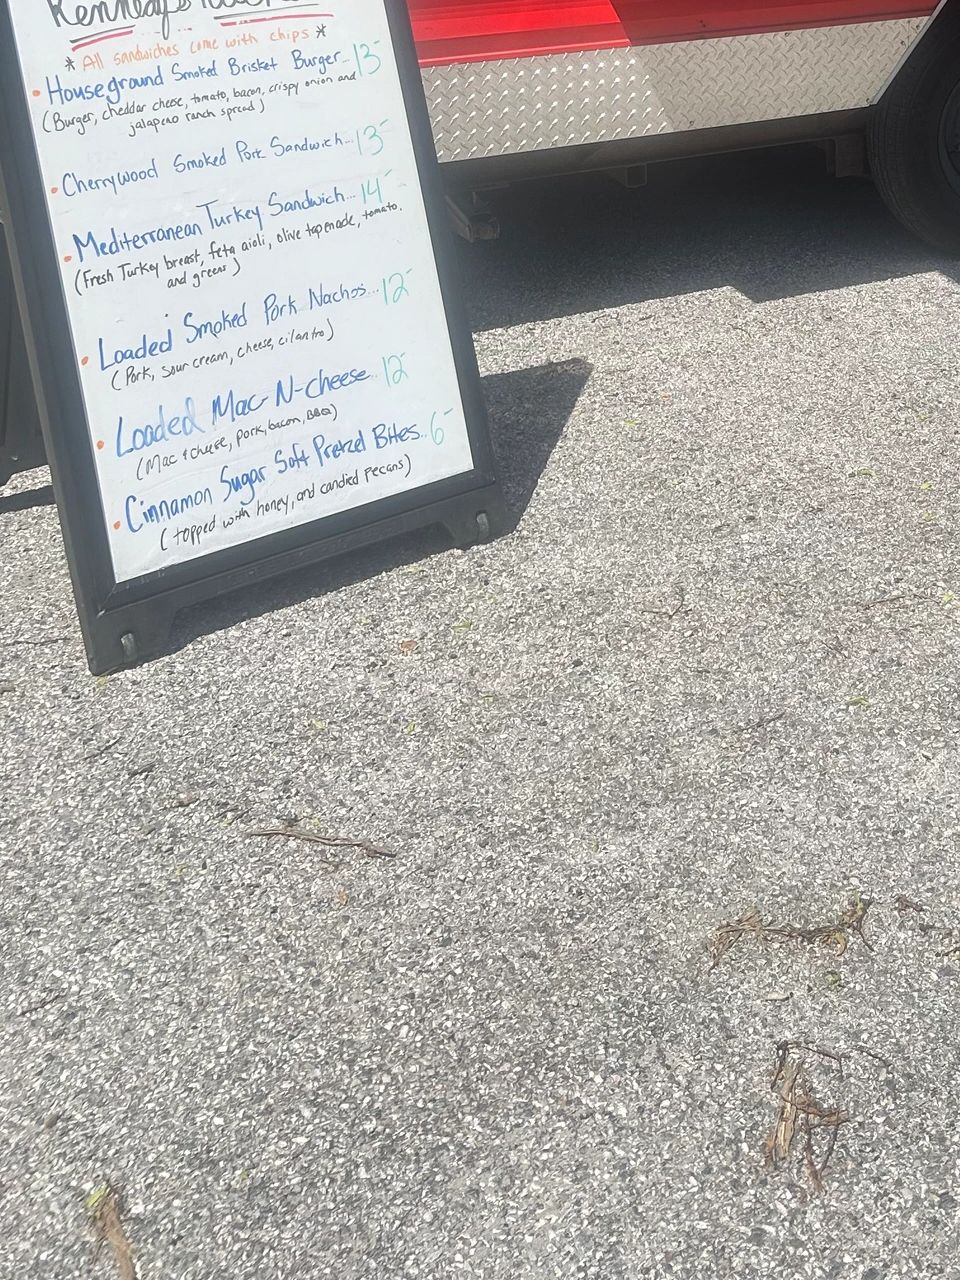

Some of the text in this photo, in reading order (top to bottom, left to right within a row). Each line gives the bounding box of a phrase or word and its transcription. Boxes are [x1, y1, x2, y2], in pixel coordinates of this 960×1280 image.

[82, 52, 105, 71] All
[113, 44, 180, 66] sandwiches
[225, 32, 258, 48] with
[270, 27, 310, 45] chips
[171, 59, 219, 82] Smoked
[227, 56, 278, 77] Brisket
[101, 100, 147, 121] cheddar
[268, 80, 300, 97] crispy
[304, 76, 333, 88] onion
[338, 71, 357, 82] and
[185, 108, 217, 122] ranch
[173, 147, 227, 173] Smoked
[235, 139, 268, 163] Pork
[72, 222, 203, 263] Mediterranean
[195, 199, 263, 232] Turkey
[117, 261, 160, 281] Turkey
[208, 240, 236, 260] feta
[276, 227, 301, 244] olive
[167, 270, 188, 289] and
[98, 328, 173, 372] Loaded
[183, 301, 248, 344] Smoked
[263, 292, 298, 326] Pork
[161, 361, 190, 379] sour
[115, 396, 206, 458] Loaded
[125, 486, 213, 534] Cinnamon
[219, 464, 269, 506] Sugar
[274, 442, 310, 474] Soft
[312, 429, 367, 467] Pretzel
[222, 506, 251, 529] with
[296, 482, 316, 502] and
[319, 470, 360, 495] candied
